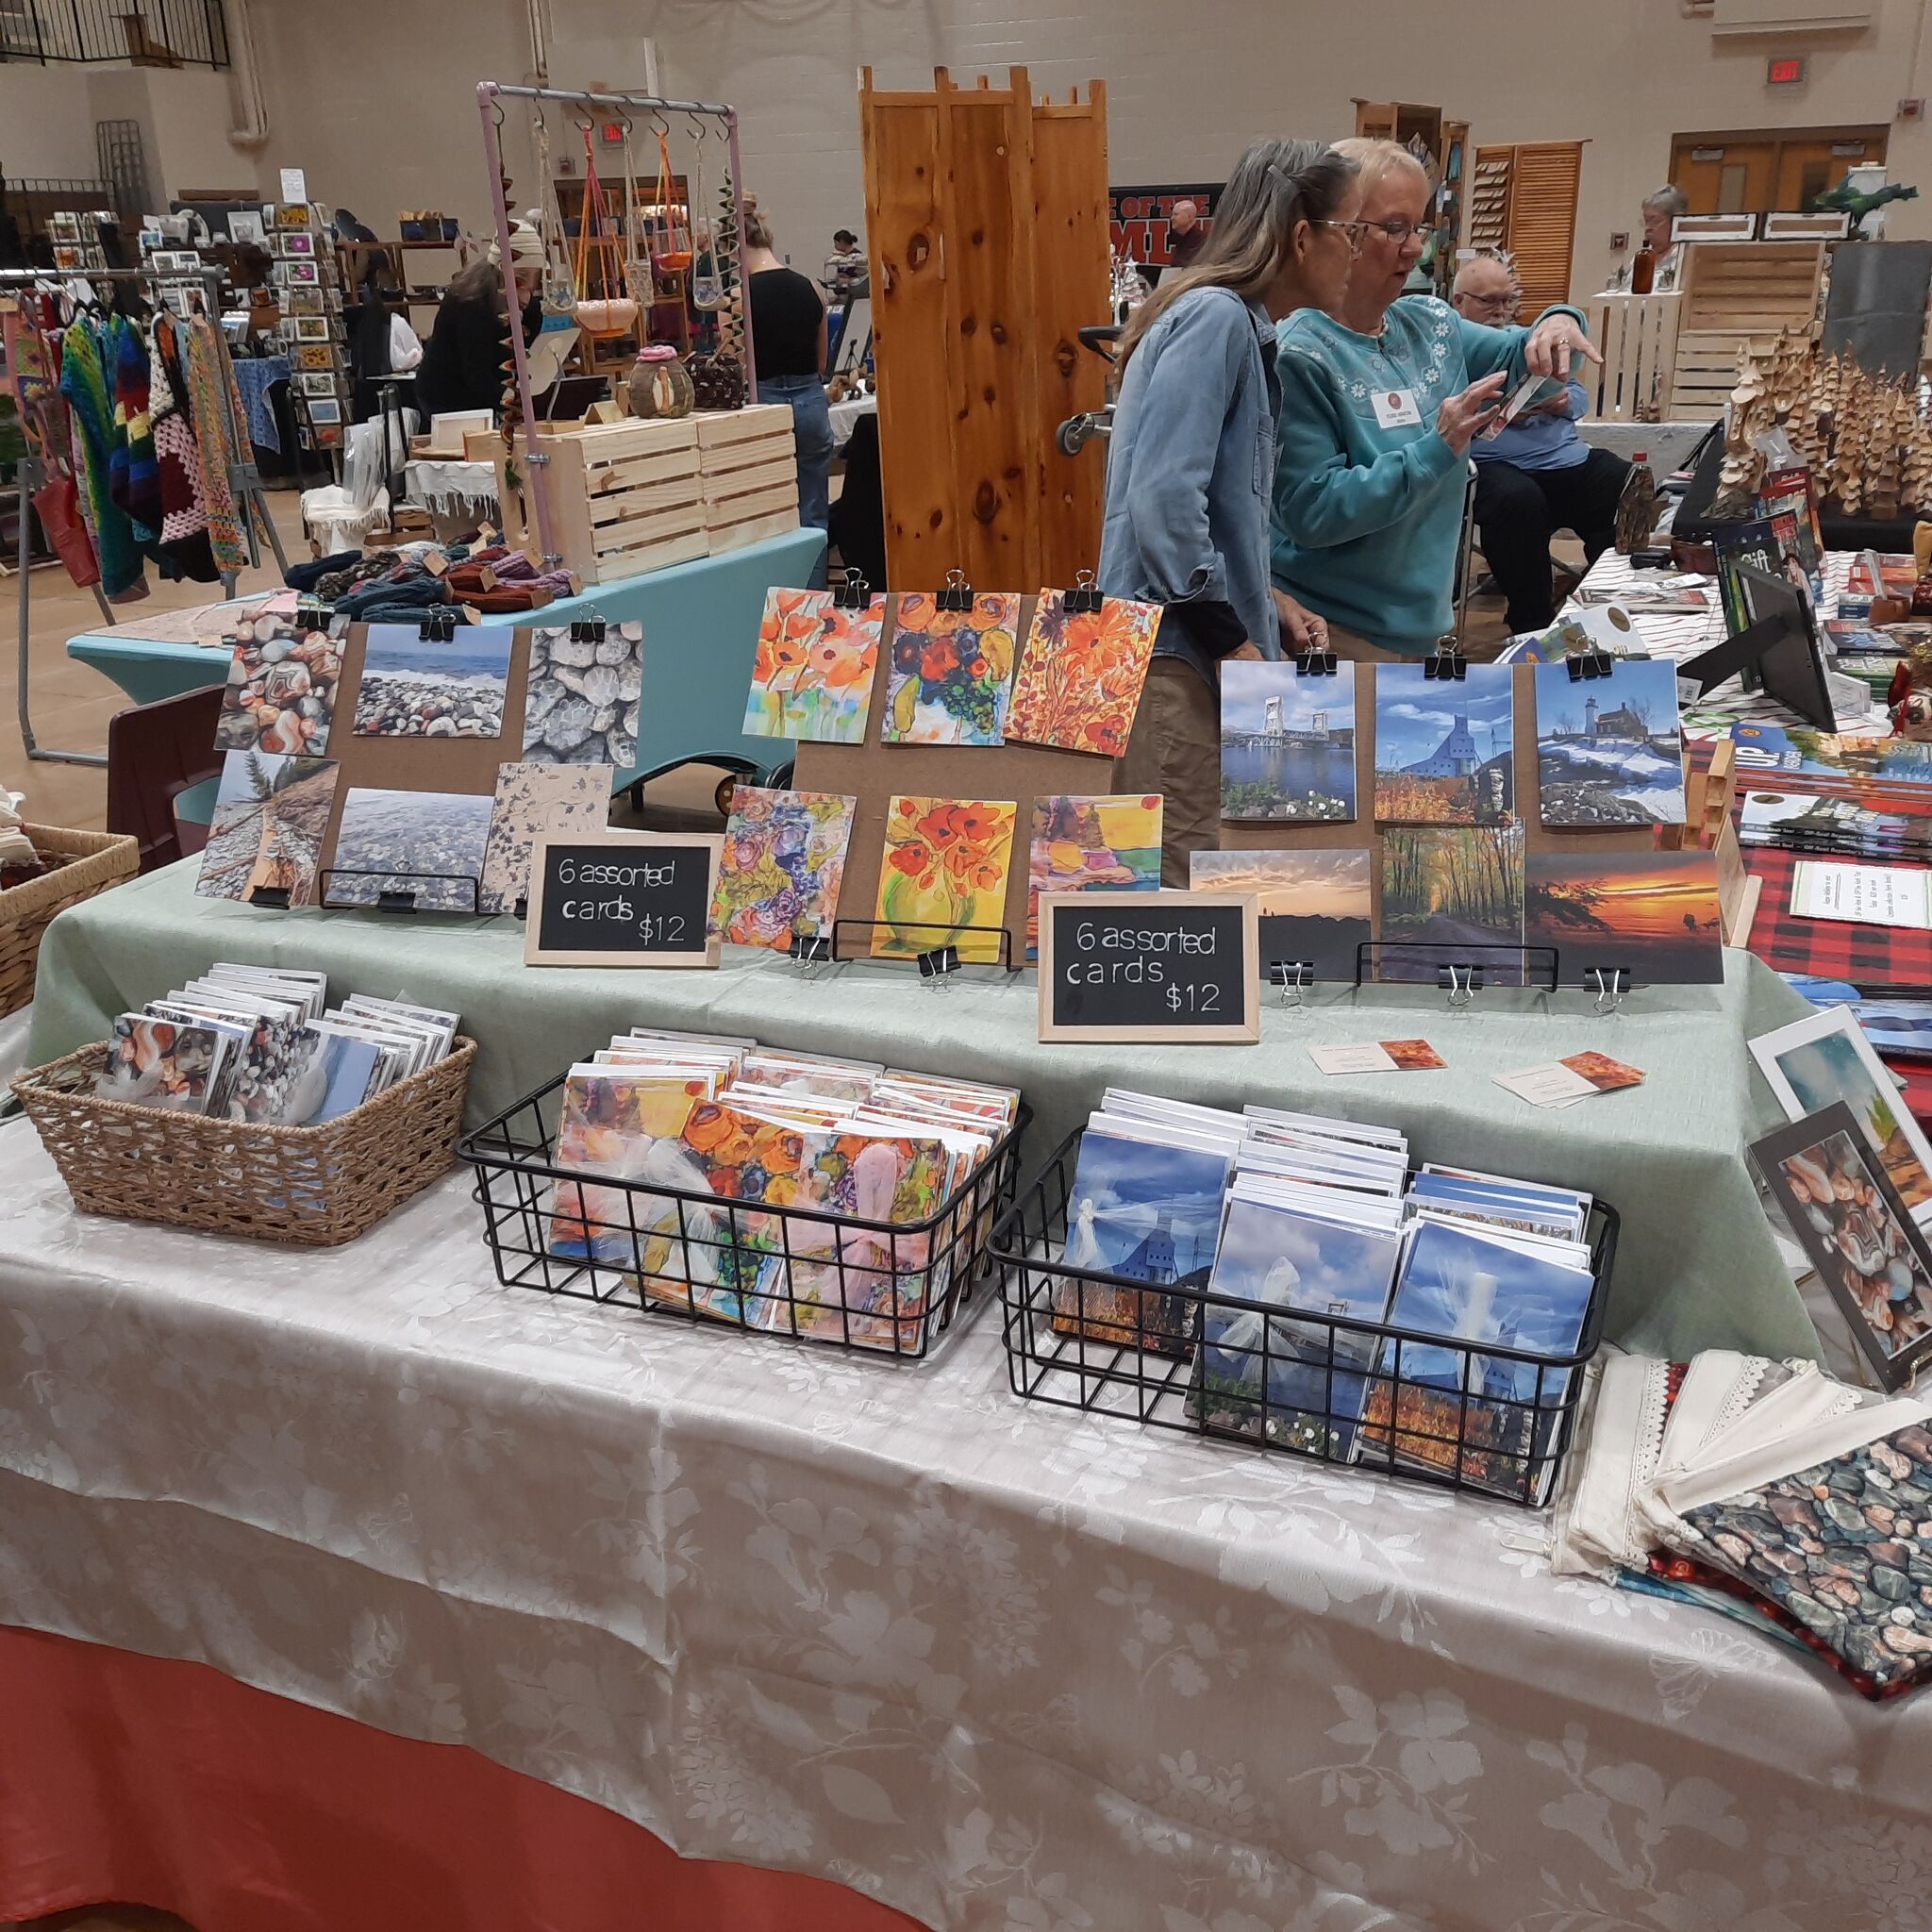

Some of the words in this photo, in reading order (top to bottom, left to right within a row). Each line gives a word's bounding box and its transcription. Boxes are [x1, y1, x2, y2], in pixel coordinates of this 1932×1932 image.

[1122, 196, 1156, 218] OF
[558, 858, 576, 885] 6
[579, 859, 676, 888] assorted
[561, 893, 635, 922] cards
[638, 912, 687, 946] $12
[1076, 922, 1096, 951] 6
[1101, 925, 1217, 955] assorted
[1066, 955, 1165, 985] cards
[1165, 981, 1222, 1013] $12
